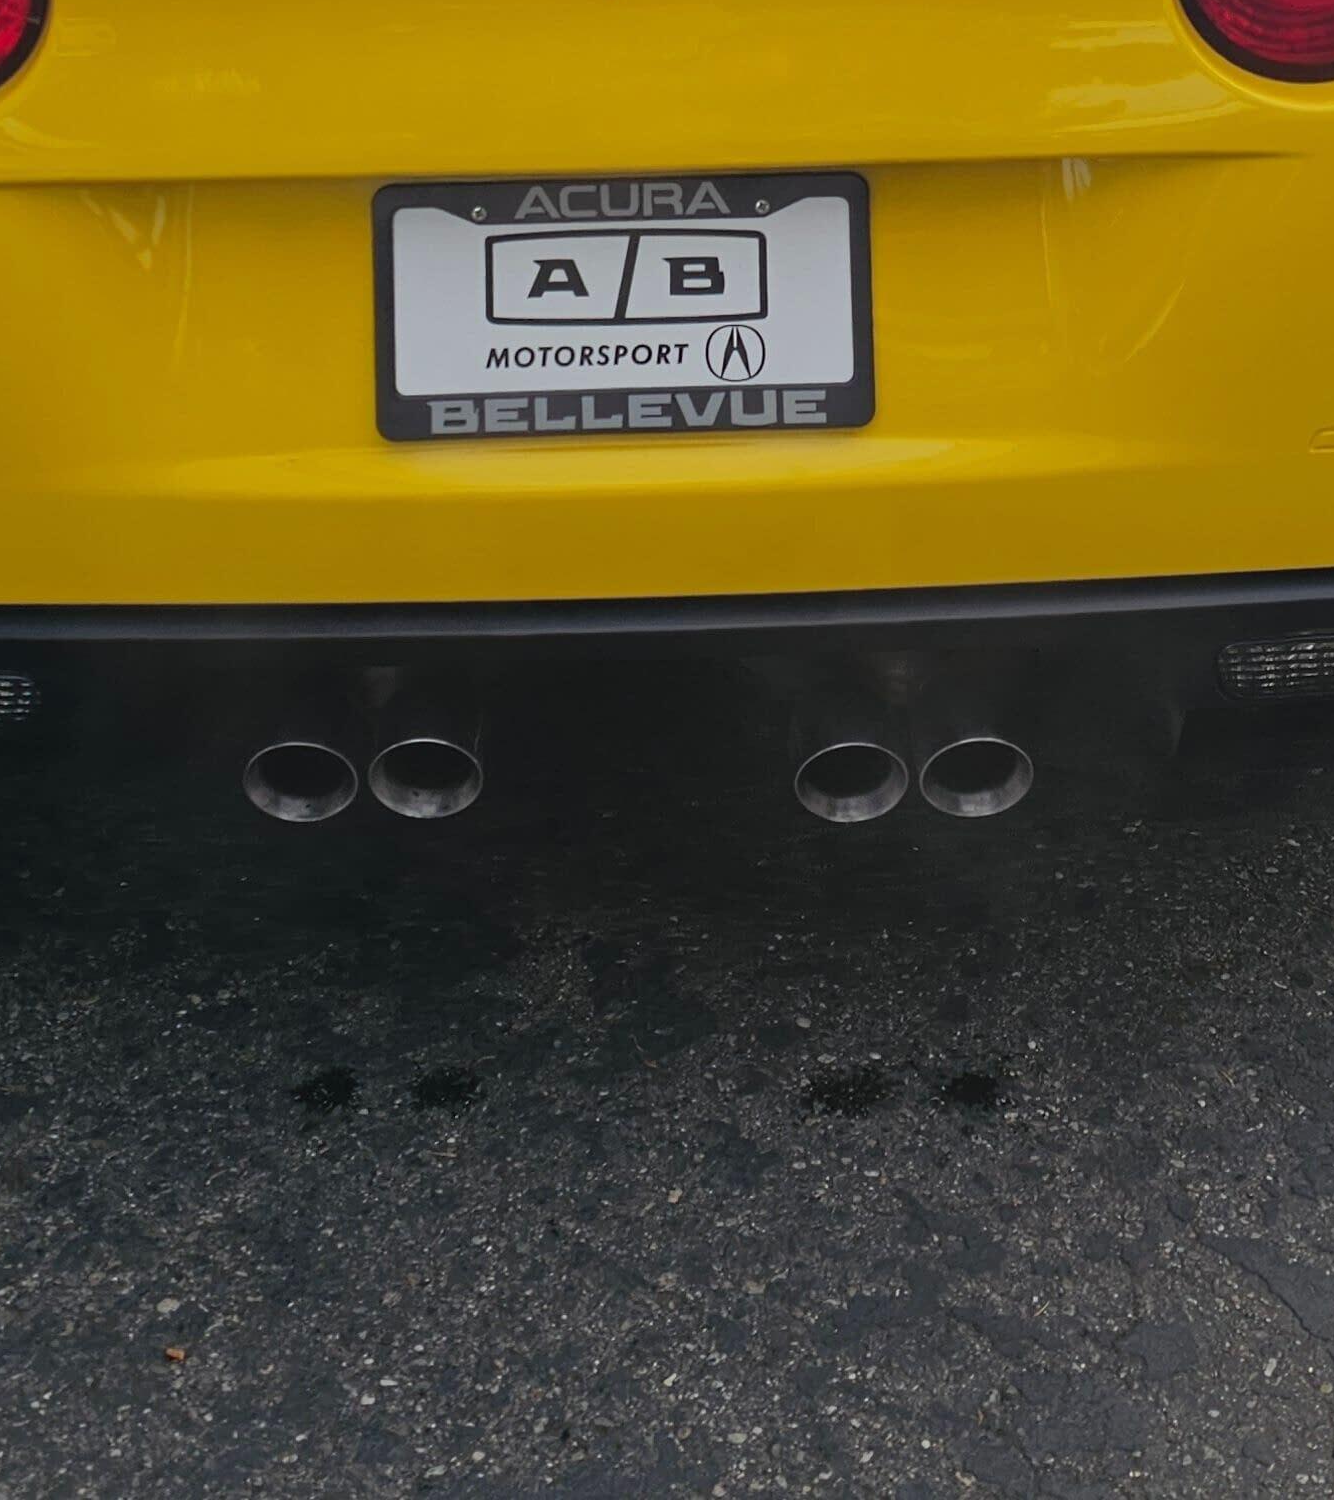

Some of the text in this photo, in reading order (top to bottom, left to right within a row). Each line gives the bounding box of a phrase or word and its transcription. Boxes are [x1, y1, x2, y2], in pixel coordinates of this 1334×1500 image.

[514, 181, 731, 220] ACURA
[527, 256, 725, 298] A B
[485, 343, 690, 369] MOTORSPORT
[427, 389, 828, 435] BELLEVUE
